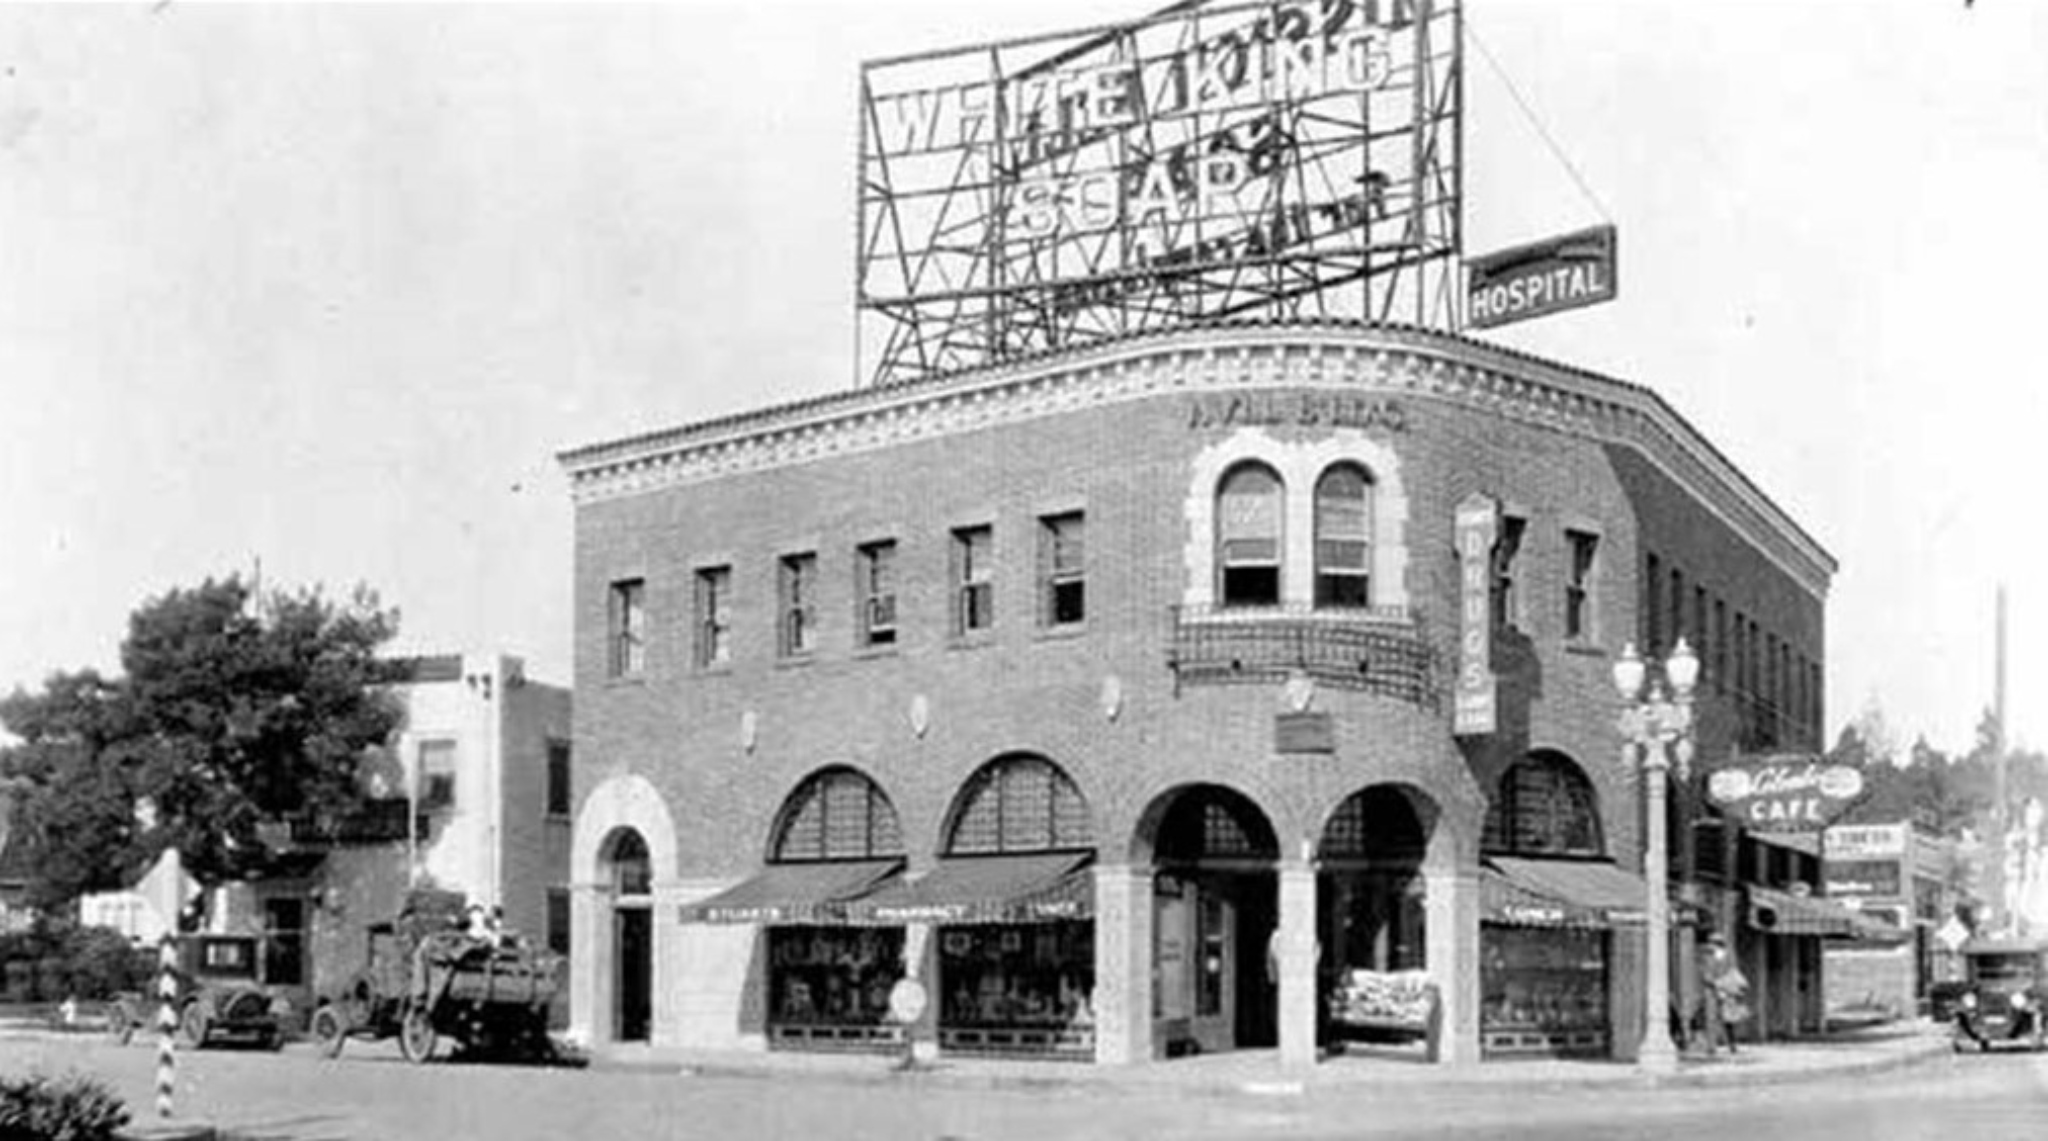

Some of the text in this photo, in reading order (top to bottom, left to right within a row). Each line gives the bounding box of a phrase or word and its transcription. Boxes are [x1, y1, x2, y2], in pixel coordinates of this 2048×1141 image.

[890, 29, 1392, 154] WHITE KING
[1008, 150, 1251, 238] SOAP
[1472, 261, 1604, 319] HOSPITAL
[1465, 530, 1485, 689] DRUGS
[1751, 799, 1823, 821] CAFE
